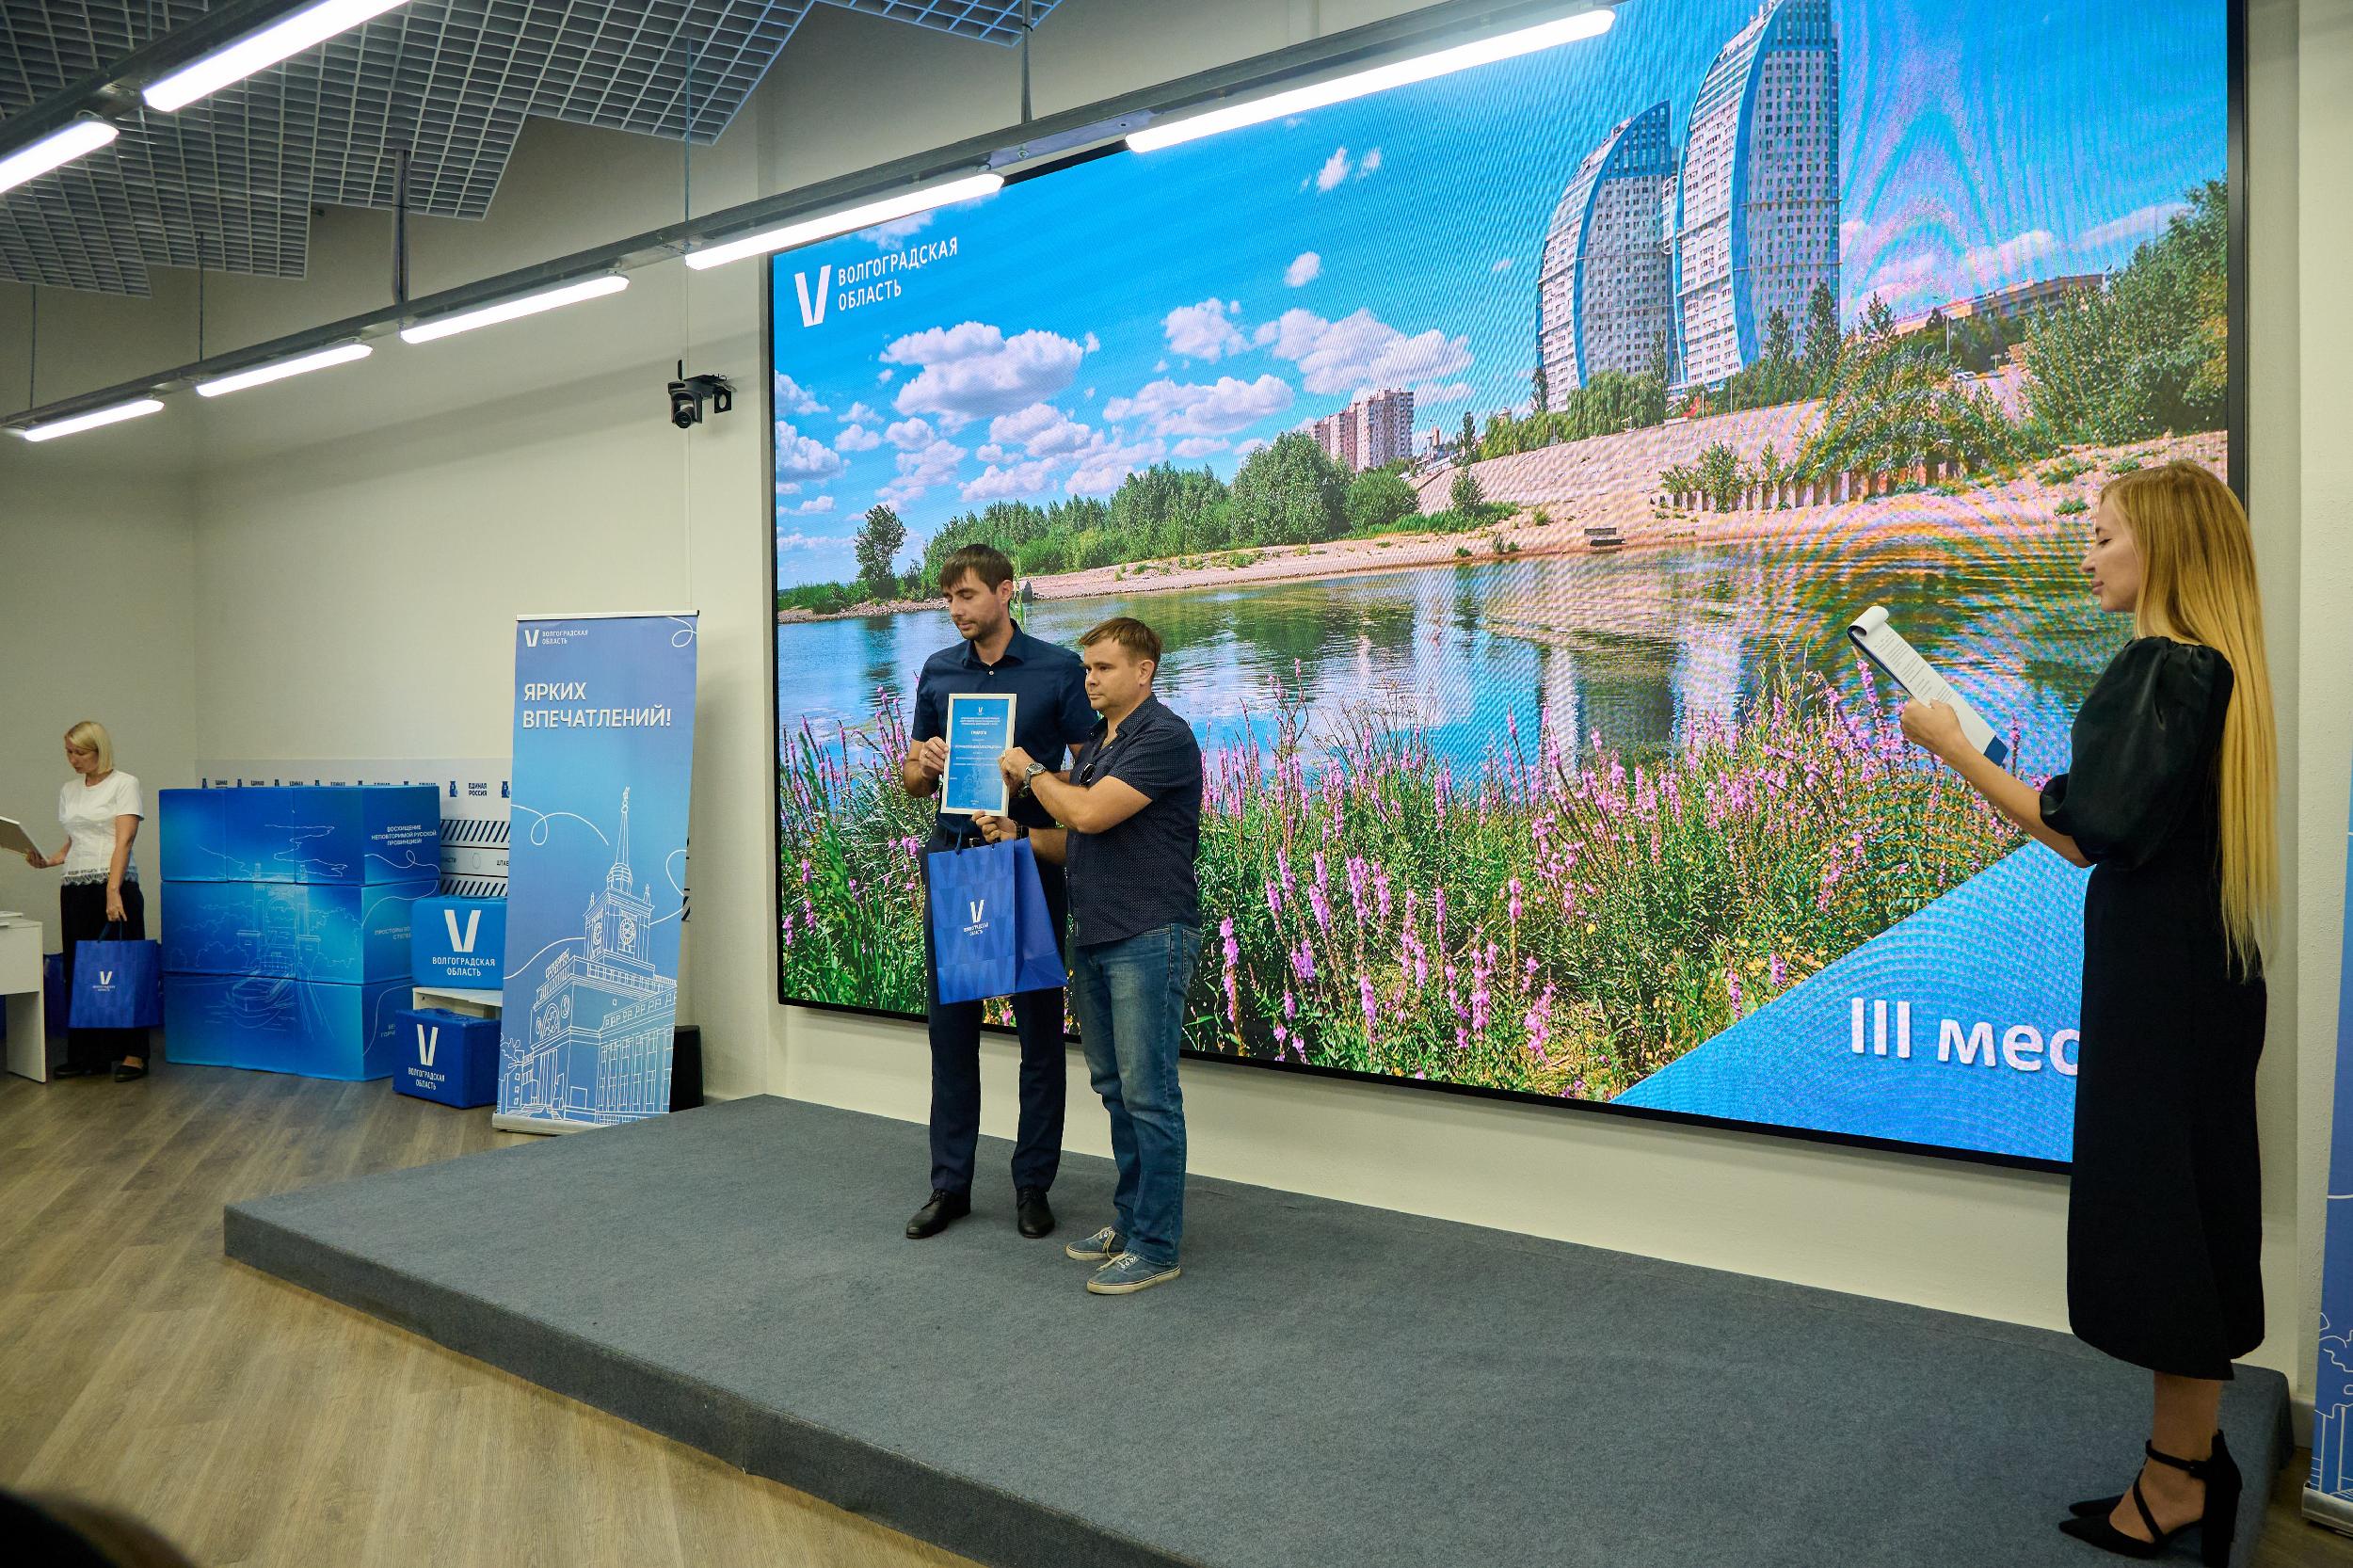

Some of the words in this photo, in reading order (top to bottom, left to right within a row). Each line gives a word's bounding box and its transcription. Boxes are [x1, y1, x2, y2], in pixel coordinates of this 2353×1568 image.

[838, 236, 958, 287] ВОЛГОГРАДСКАЯ
[838, 280, 902, 312] ОБЛАСТЬ
[524, 681, 587, 701] ЯРКИХ
[522, 704, 671, 728] ВПЕЧАТЛЕНИЙ!
[432, 956, 496, 967] ВОЛГОГРАДСКАЯ
[446, 968, 482, 977] ОБЛАСТЬ
[1850, 997, 1911, 1059] III
[1937, 1018, 2080, 1076] мес
[408, 1066, 445, 1082] ВОЛГОГРАДСКАЯ
[415, 1079, 437, 1090] ОБЛАСТЬ
